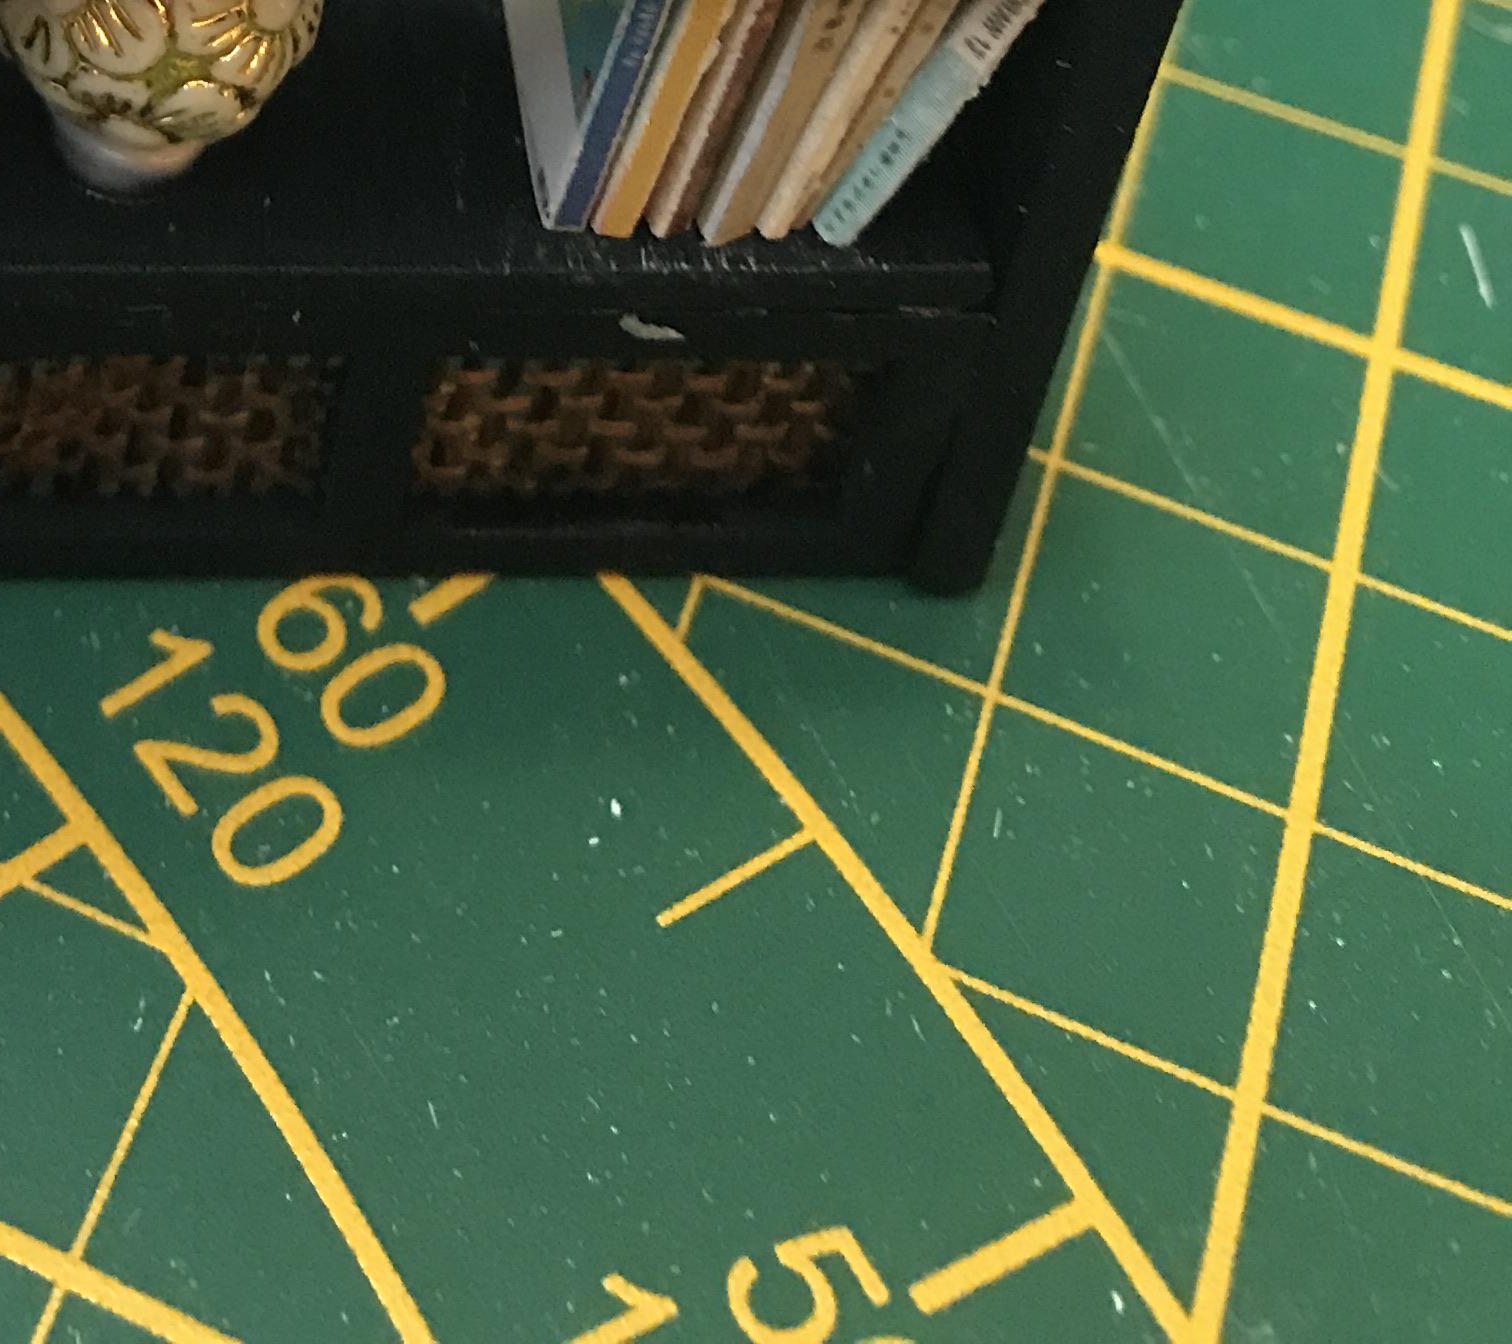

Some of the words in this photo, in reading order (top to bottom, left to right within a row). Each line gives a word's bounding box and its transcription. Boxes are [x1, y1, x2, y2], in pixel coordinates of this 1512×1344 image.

[256, 574, 447, 748] 60
[100, 629, 345, 887] 120
[727, 1225, 915, 1344] 5
